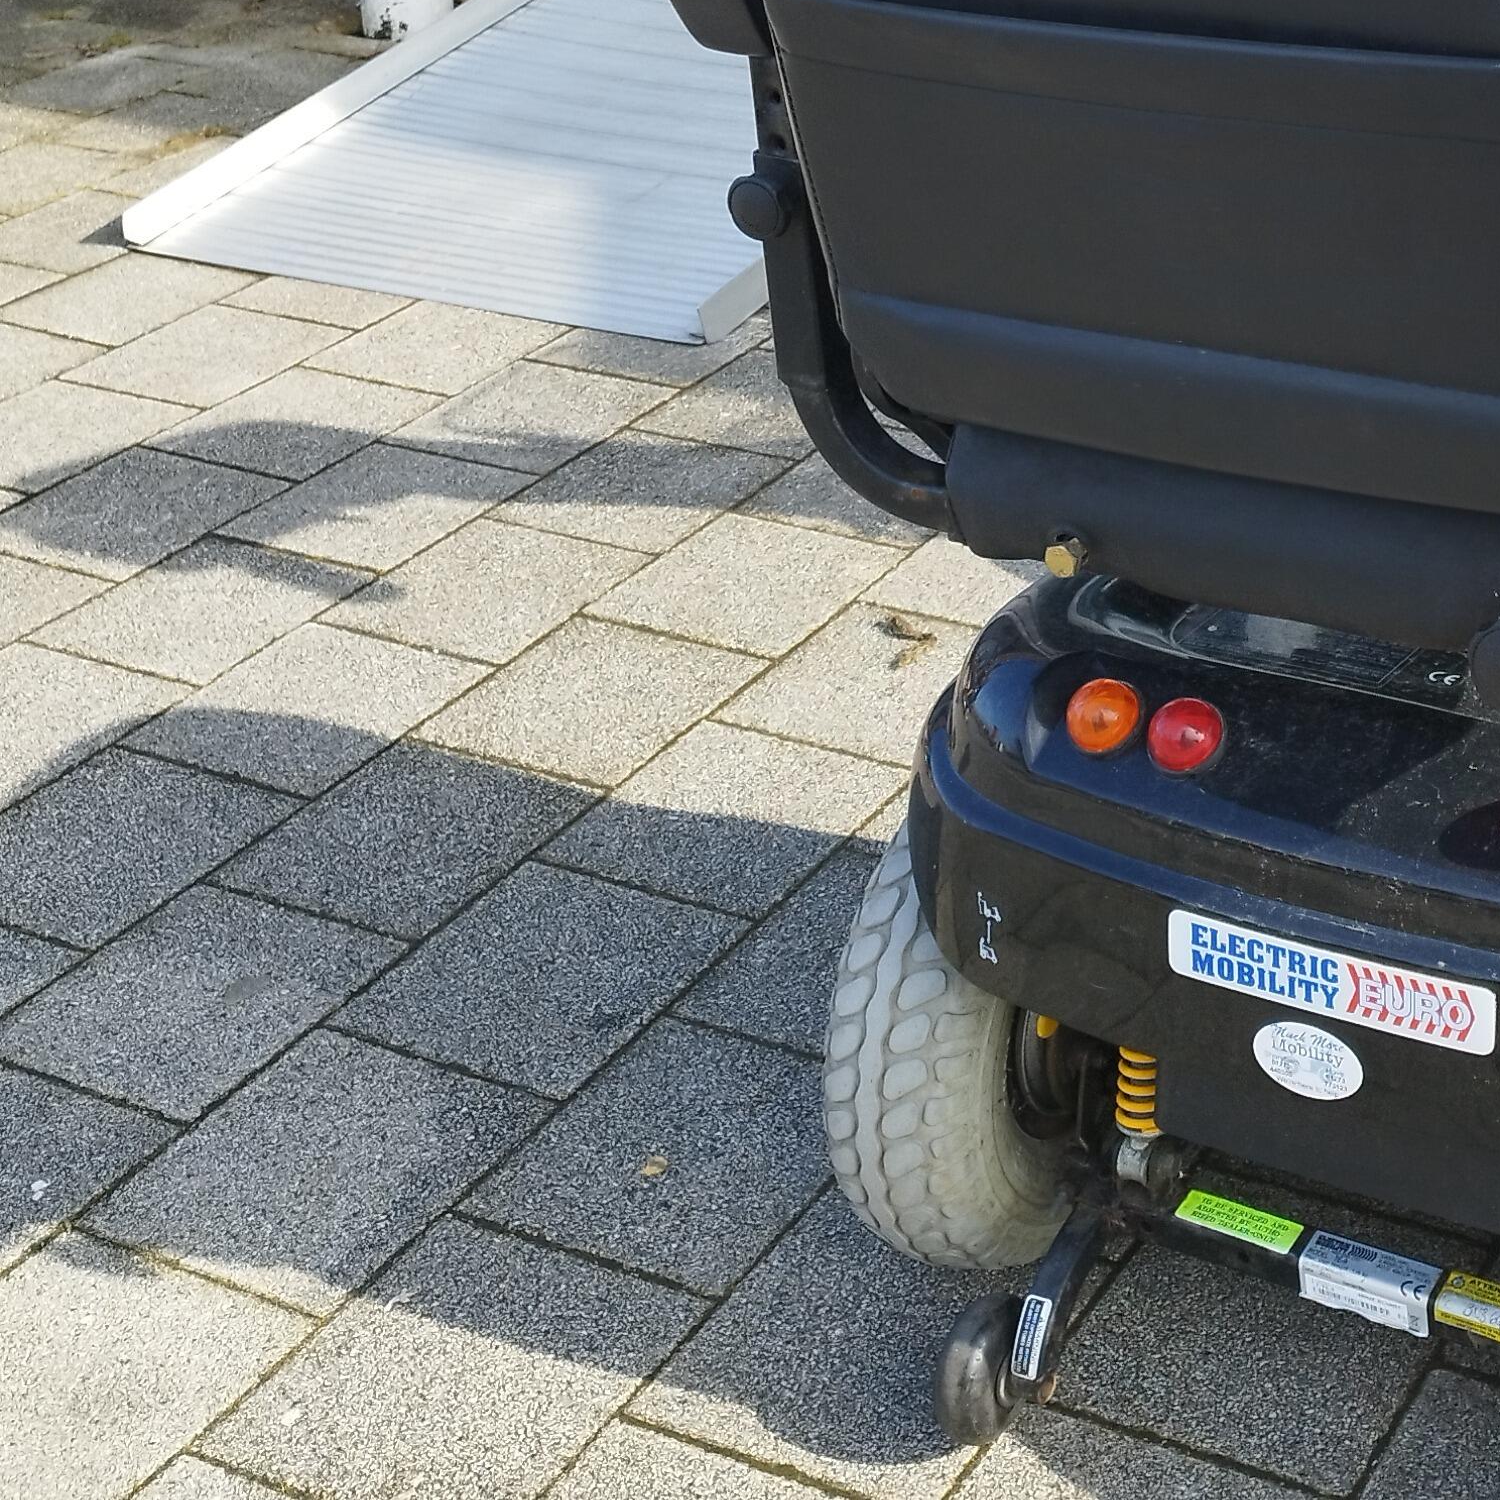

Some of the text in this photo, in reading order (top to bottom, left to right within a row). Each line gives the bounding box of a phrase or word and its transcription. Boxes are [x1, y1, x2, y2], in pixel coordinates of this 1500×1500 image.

[1191, 922, 1339, 984] ELECTRIC
[1191, 948, 1472, 1032] MOBILITY EURO
[1271, 1024, 1344, 1052] Much More
[1272, 1038, 1344, 1068] Mobility
[1401, 1280, 1427, 1301] CE
